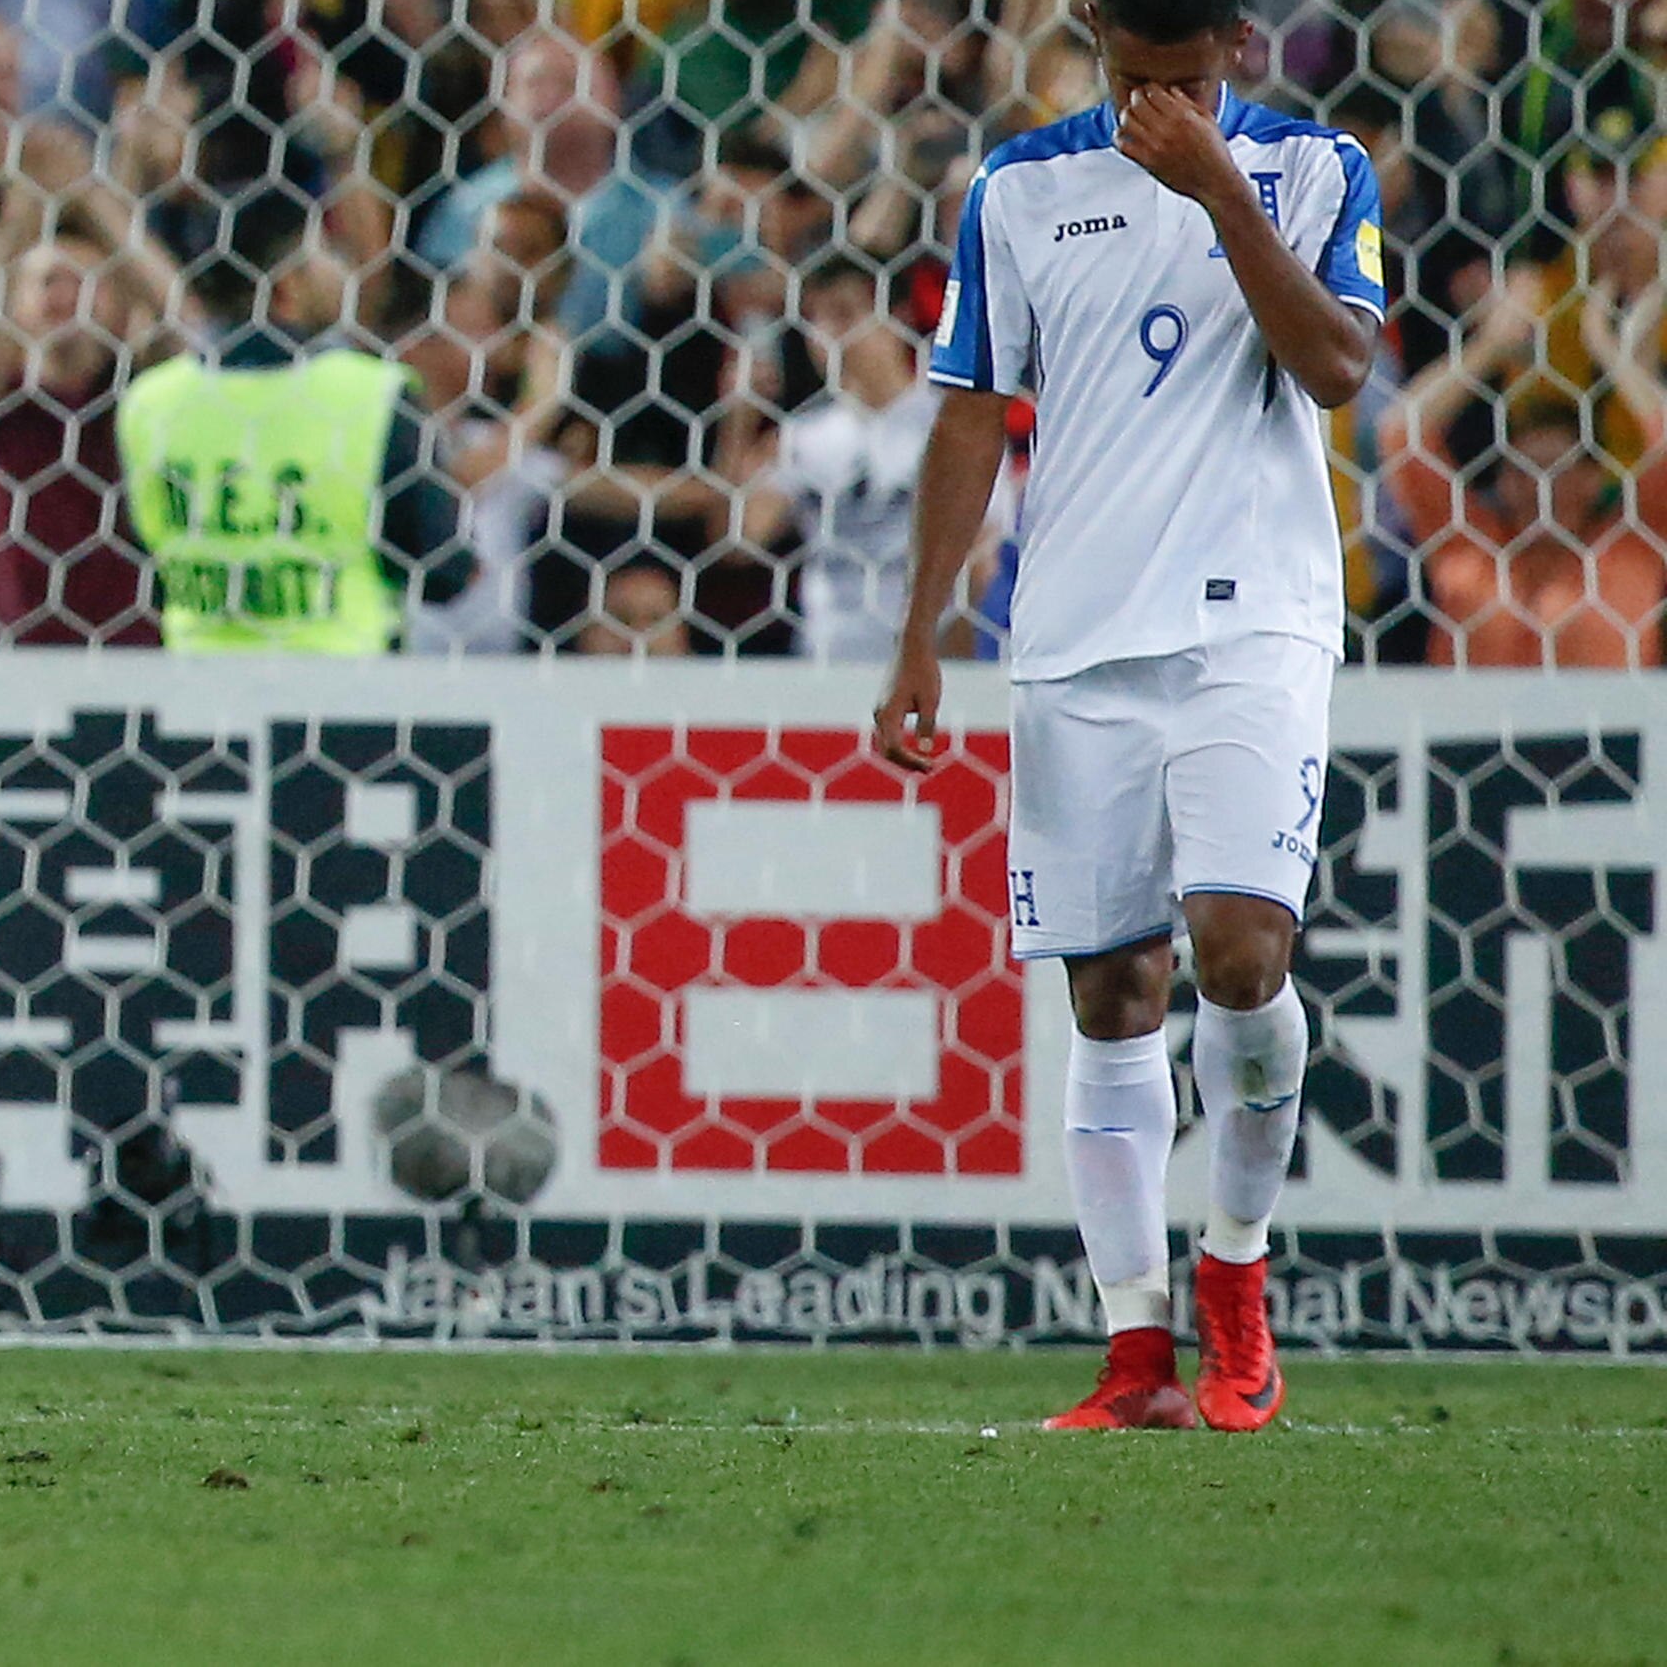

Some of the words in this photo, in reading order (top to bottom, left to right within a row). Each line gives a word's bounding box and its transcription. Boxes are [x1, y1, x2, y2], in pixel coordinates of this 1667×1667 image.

[1140, 303, 1189, 397] 9
[685, 1249, 1005, 1342] Leading
[1032, 1254, 1360, 1336] Ninal
